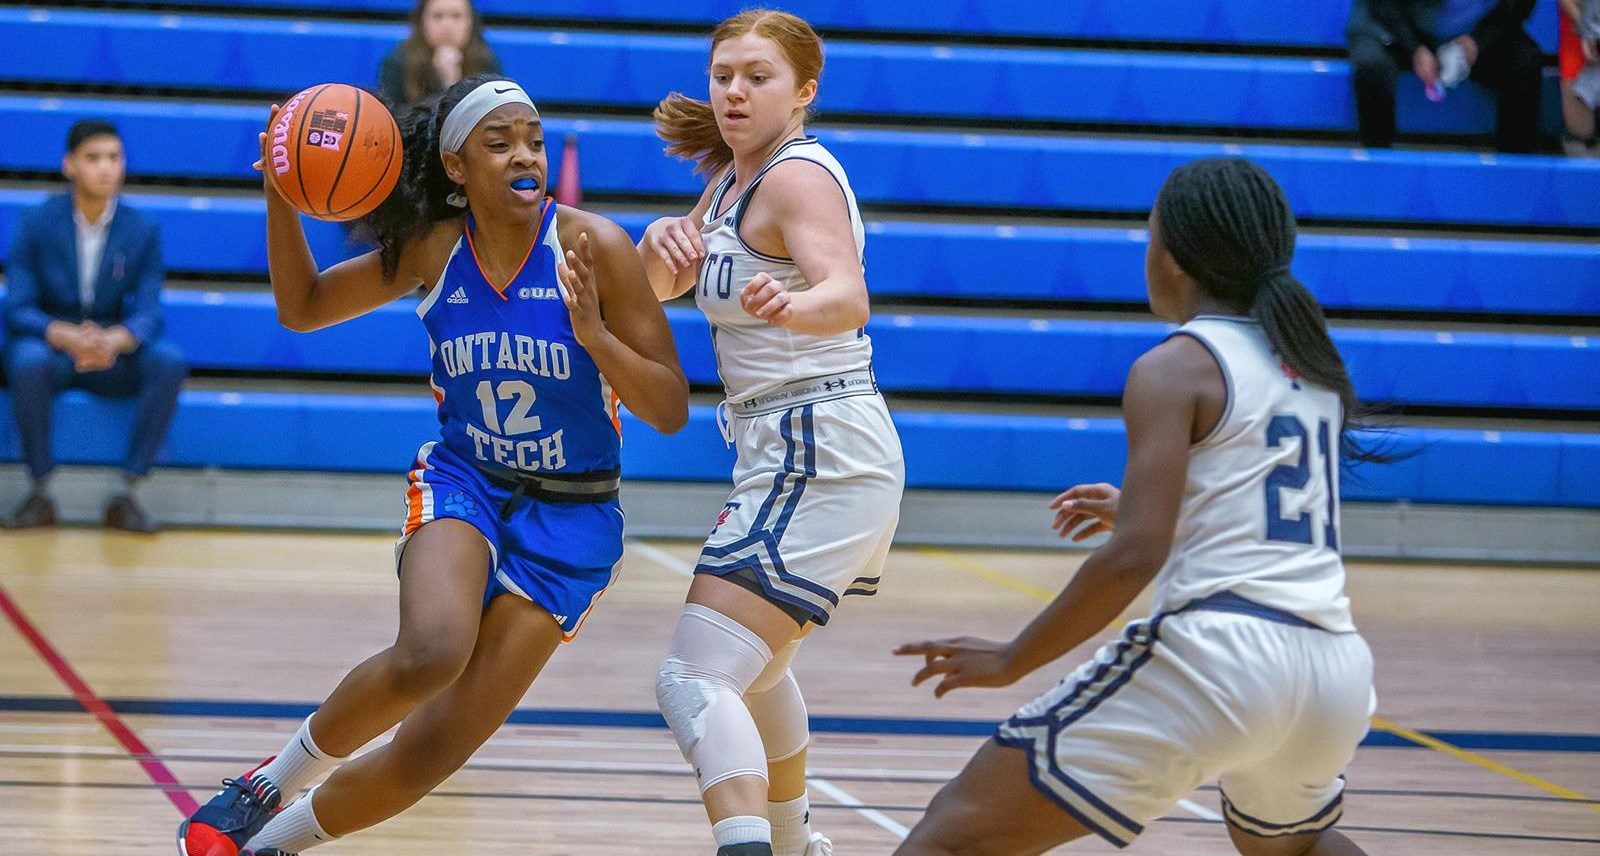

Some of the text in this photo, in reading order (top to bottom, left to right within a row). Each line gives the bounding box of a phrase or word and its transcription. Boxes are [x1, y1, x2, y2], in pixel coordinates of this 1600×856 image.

[518, 287, 560, 300] OUA
[440, 331, 571, 380] ONTARIO
[475, 380, 542, 436] 12
[466, 422, 567, 471] TECH
[1266, 415, 1338, 551] 21
